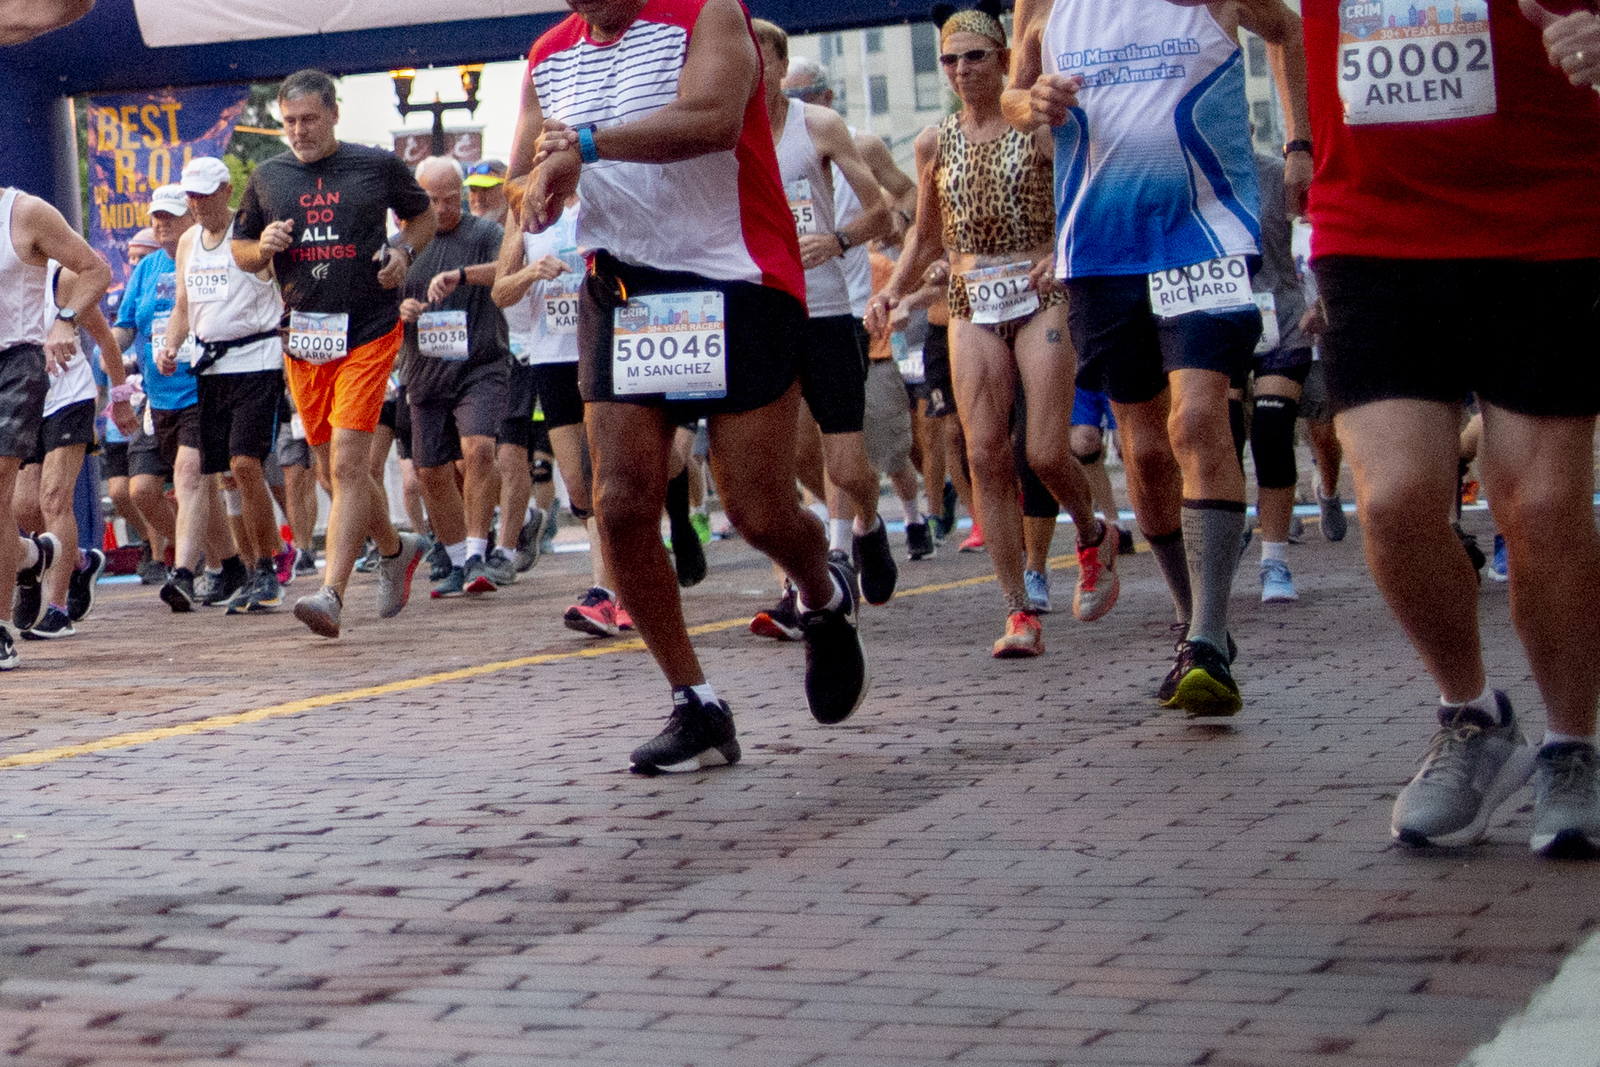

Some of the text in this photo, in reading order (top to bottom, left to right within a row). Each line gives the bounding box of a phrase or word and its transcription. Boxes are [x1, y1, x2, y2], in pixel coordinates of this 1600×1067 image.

[1346, 3, 1381, 18] CRIM
[1403, 25, 1436, 38] YEAR
[1439, 22, 1485, 36] RACER
[1057, 38, 1200, 71] 100 Marathon Club
[1342, 38, 1490, 82] 50002
[1116, 63, 1185, 83] America
[1365, 77, 1463, 106] ARLEN
[97, 102, 182, 152] BEST
[317, 177, 322, 190] I
[299, 192, 340, 207] CAN
[306, 209, 334, 224] DO
[301, 225, 340, 243] ALL
[290, 244, 357, 262] THINGS
[187, 275, 228, 287] 50195
[1152, 259, 1245, 292] 50060
[198, 287, 217, 295] TOM
[1160, 282, 1238, 305] RICHARD
[620, 307, 649, 318] CRIM
[664, 323, 688, 332] YEAR
[689, 322, 720, 331] RACER
[290, 335, 345, 352] 50009
[420, 331, 466, 344] 50038
[298, 350, 333, 360] LARRY
[616, 334, 722, 362] 50046
[627, 362, 711, 378] M SANCHEZ
